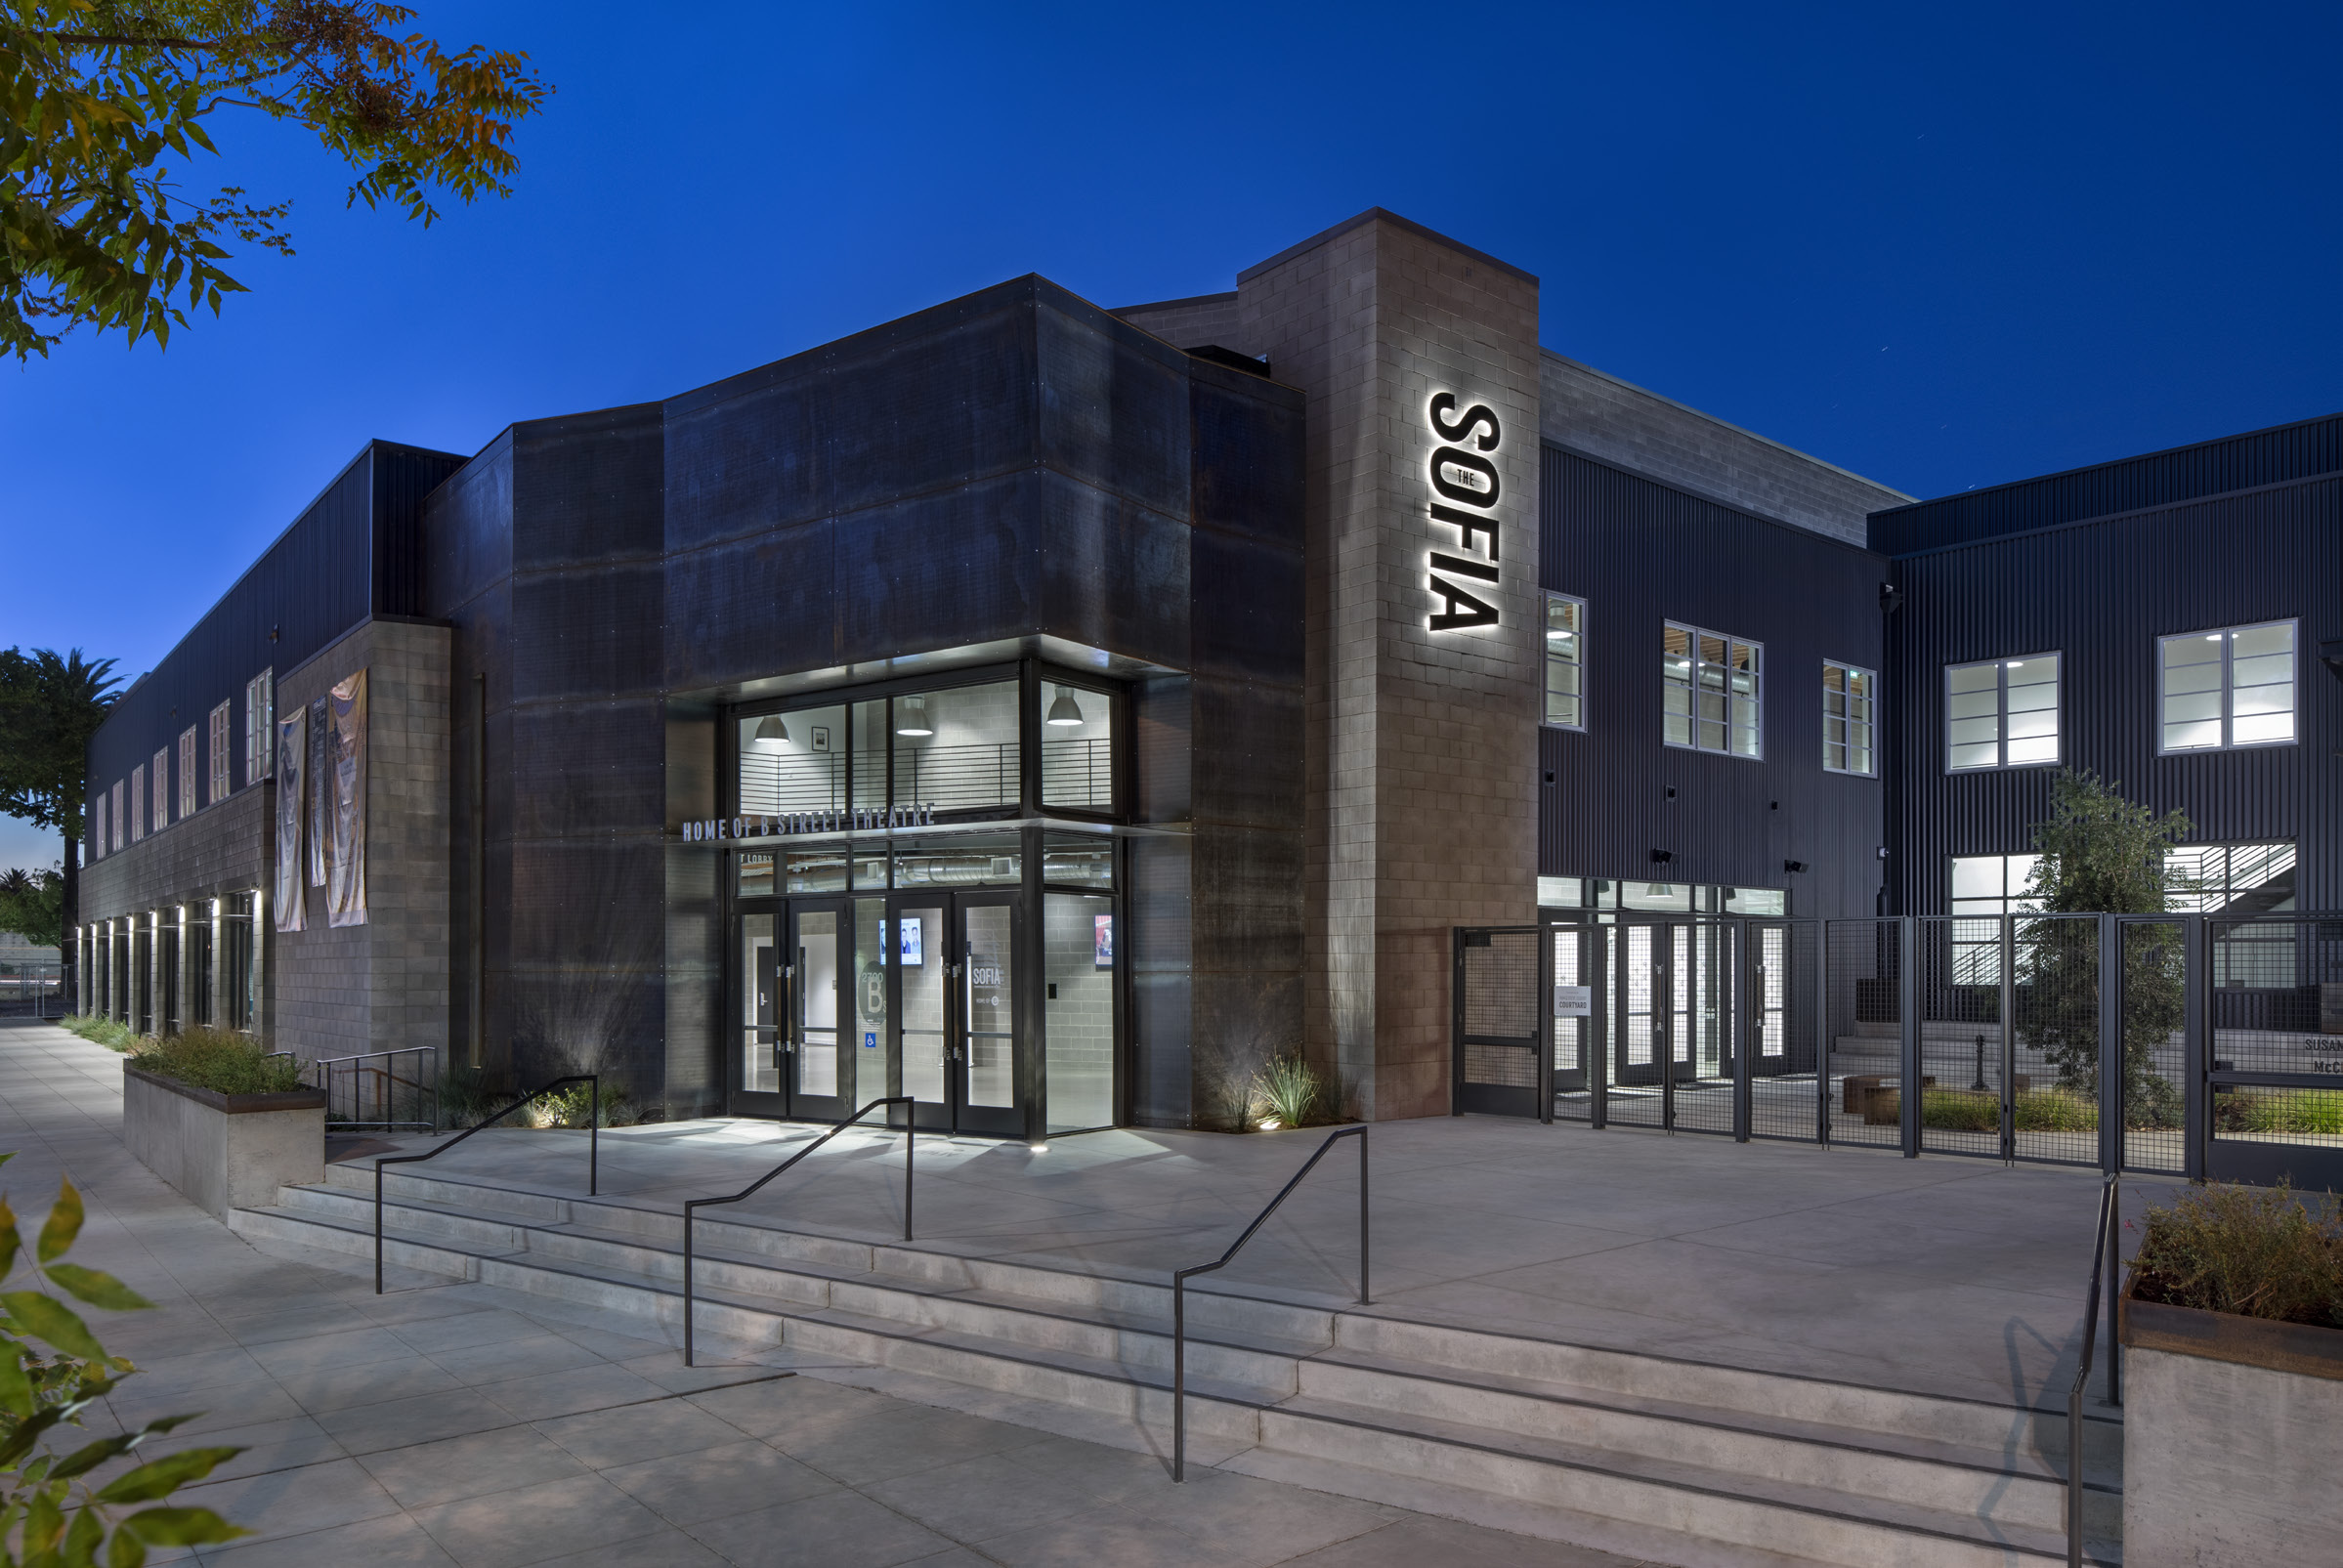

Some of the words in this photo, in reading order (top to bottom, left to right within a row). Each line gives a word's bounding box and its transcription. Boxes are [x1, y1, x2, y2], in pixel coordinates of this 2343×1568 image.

[1457, 468, 1475, 487] THE
[1428, 392, 1501, 631] SOFIA
[683, 819, 727, 842] HOME
[734, 817, 752, 838] OF
[761, 815, 770, 836] B
[777, 809, 843, 835] STREET
[851, 802, 935, 830] THEATRE
[747, 854, 773, 864] LOBBY
[973, 967, 1001, 985] SOFIA
[868, 978, 883, 1014] B
[1558, 1000, 1587, 1009] COURTYARD
